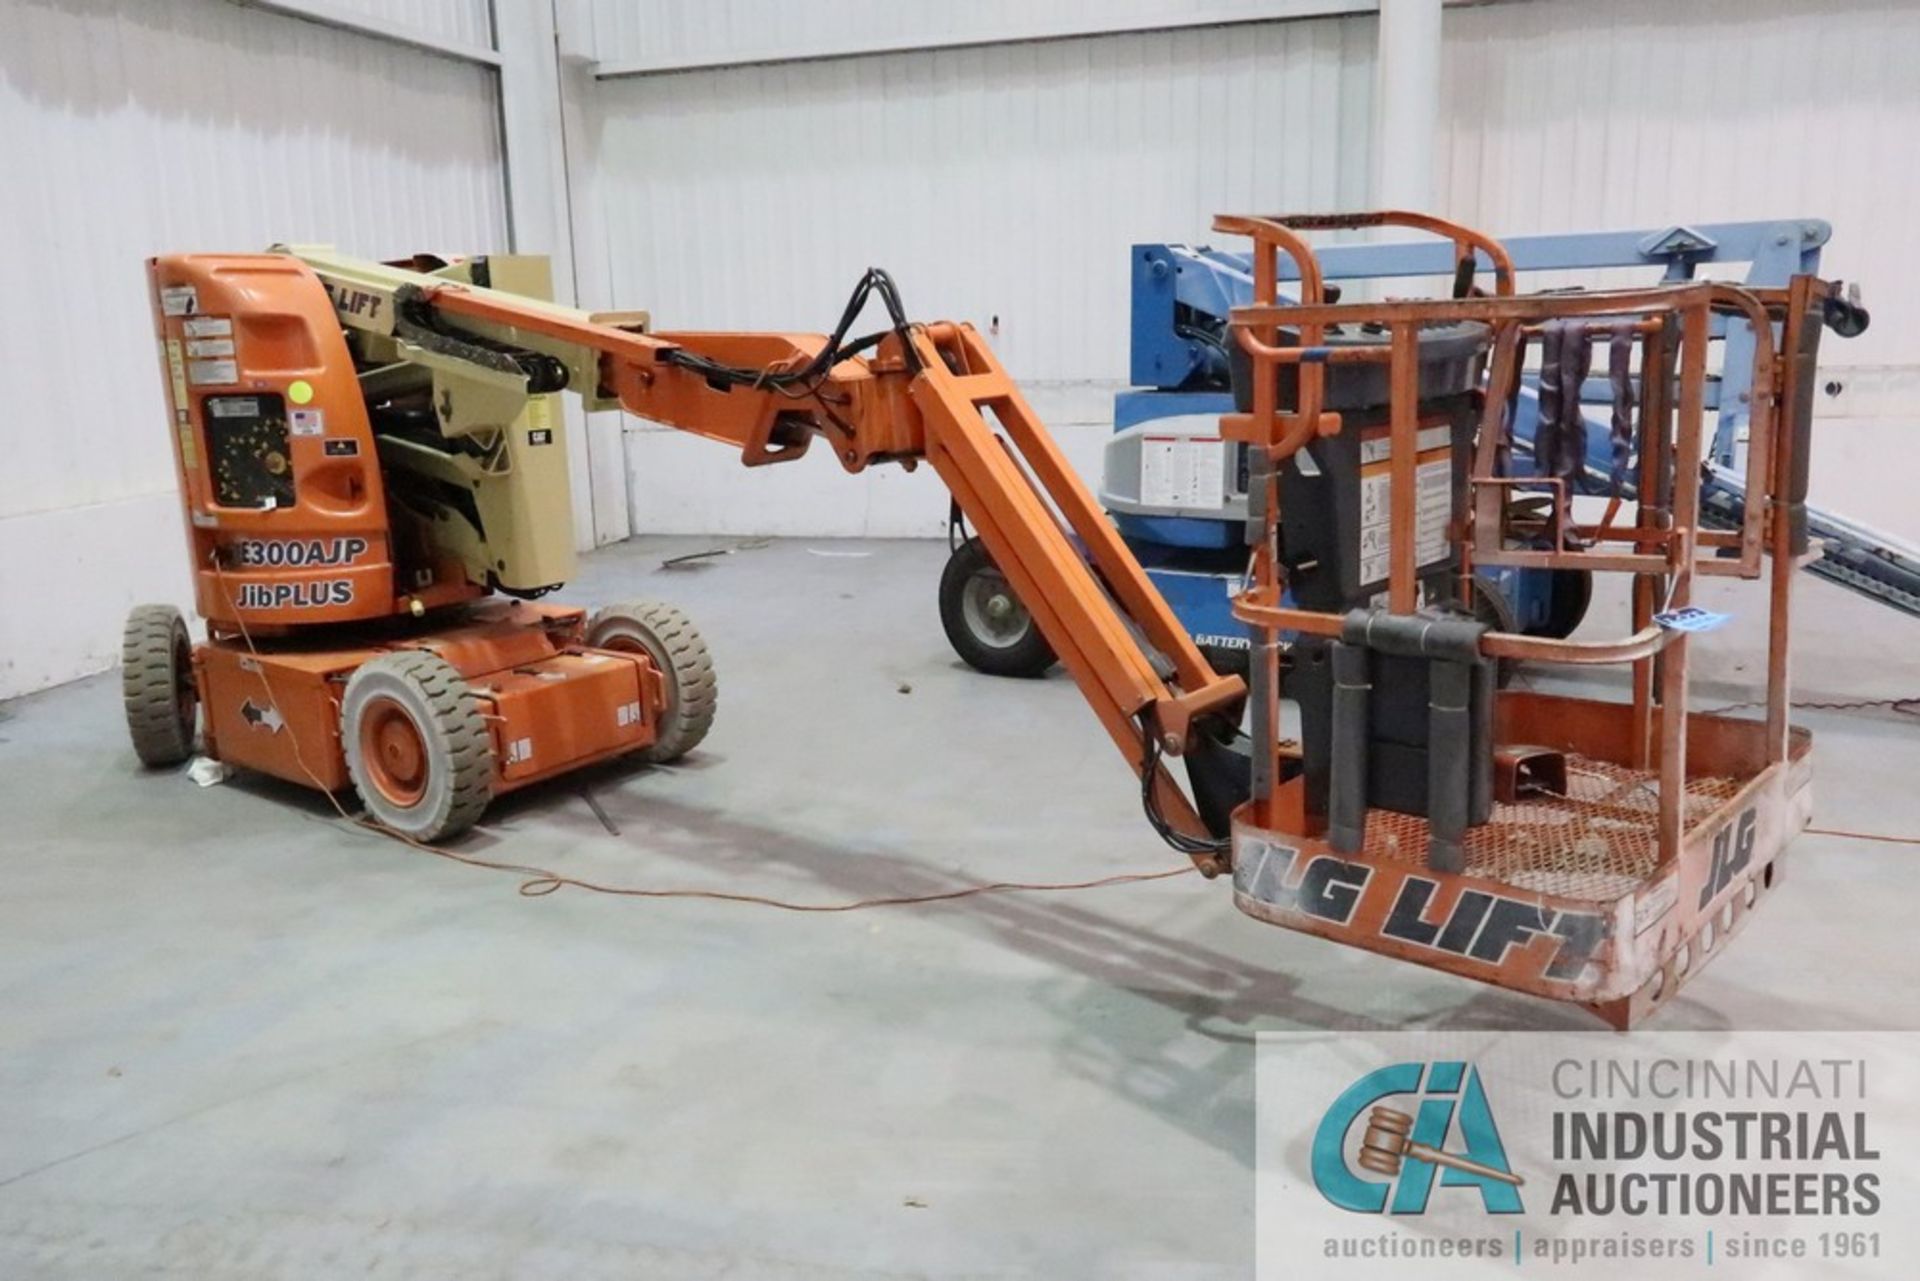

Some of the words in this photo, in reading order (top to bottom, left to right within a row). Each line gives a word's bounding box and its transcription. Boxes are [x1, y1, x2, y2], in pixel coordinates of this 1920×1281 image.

[338, 287, 382, 318] LIFT
[237, 579, 354, 609] JibPLUS
[1195, 633, 1252, 650] BATTERY
[1699, 806, 1757, 912] JLG
[1380, 874, 1608, 981] LIFT
